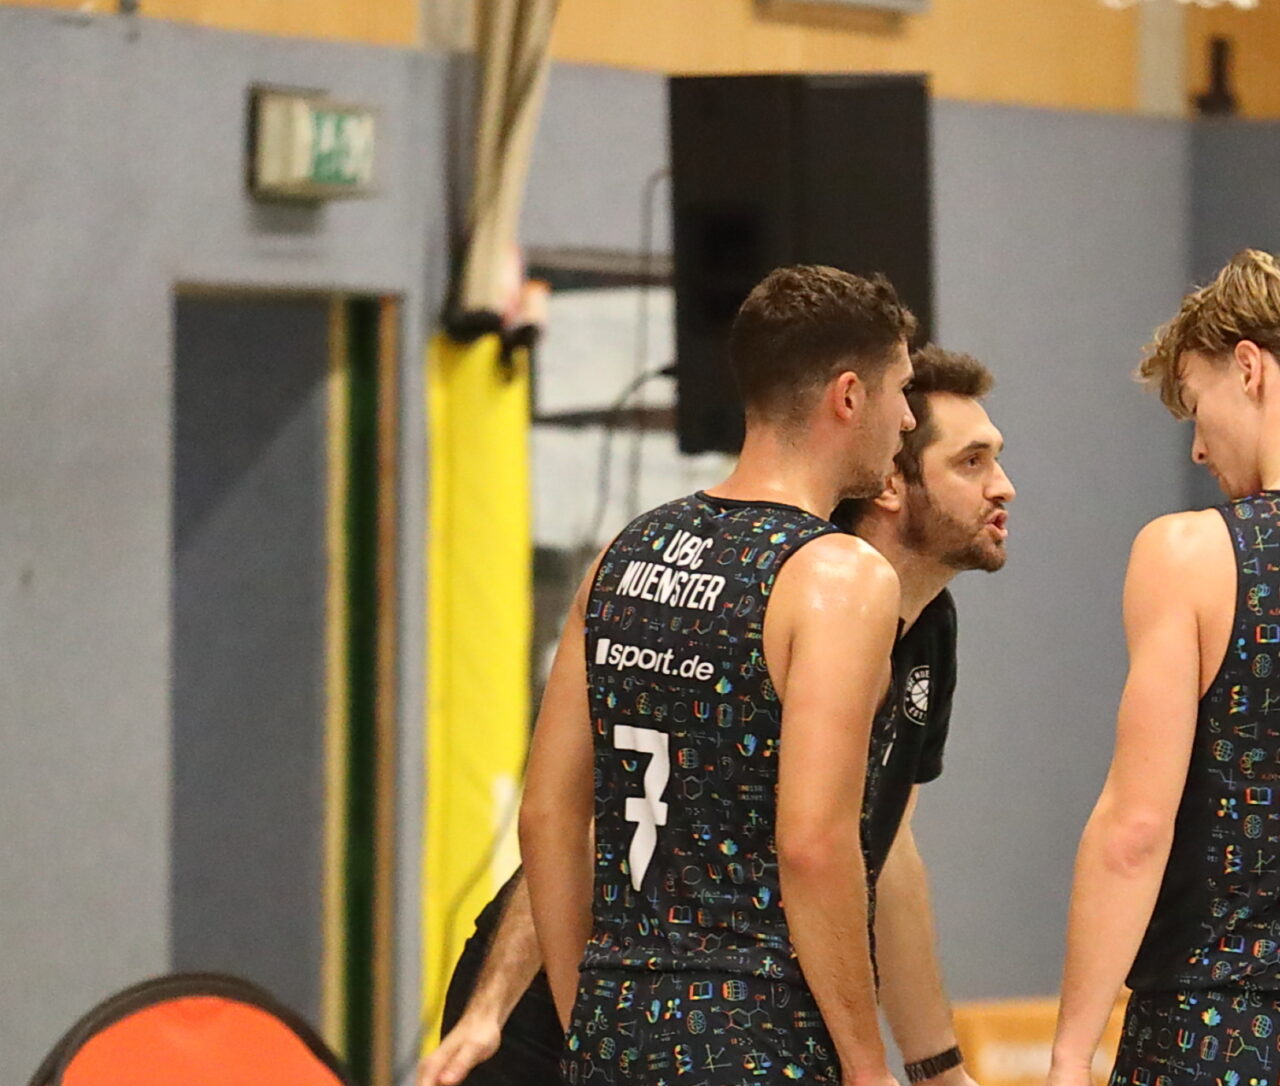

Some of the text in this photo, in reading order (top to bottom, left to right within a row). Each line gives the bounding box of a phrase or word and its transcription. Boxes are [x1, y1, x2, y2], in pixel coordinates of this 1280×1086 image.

[664, 530, 713, 568] UBC
[616, 561, 726, 611] MUENSTER
[608, 641, 714, 681] sport.de
[614, 724, 671, 893] 7
